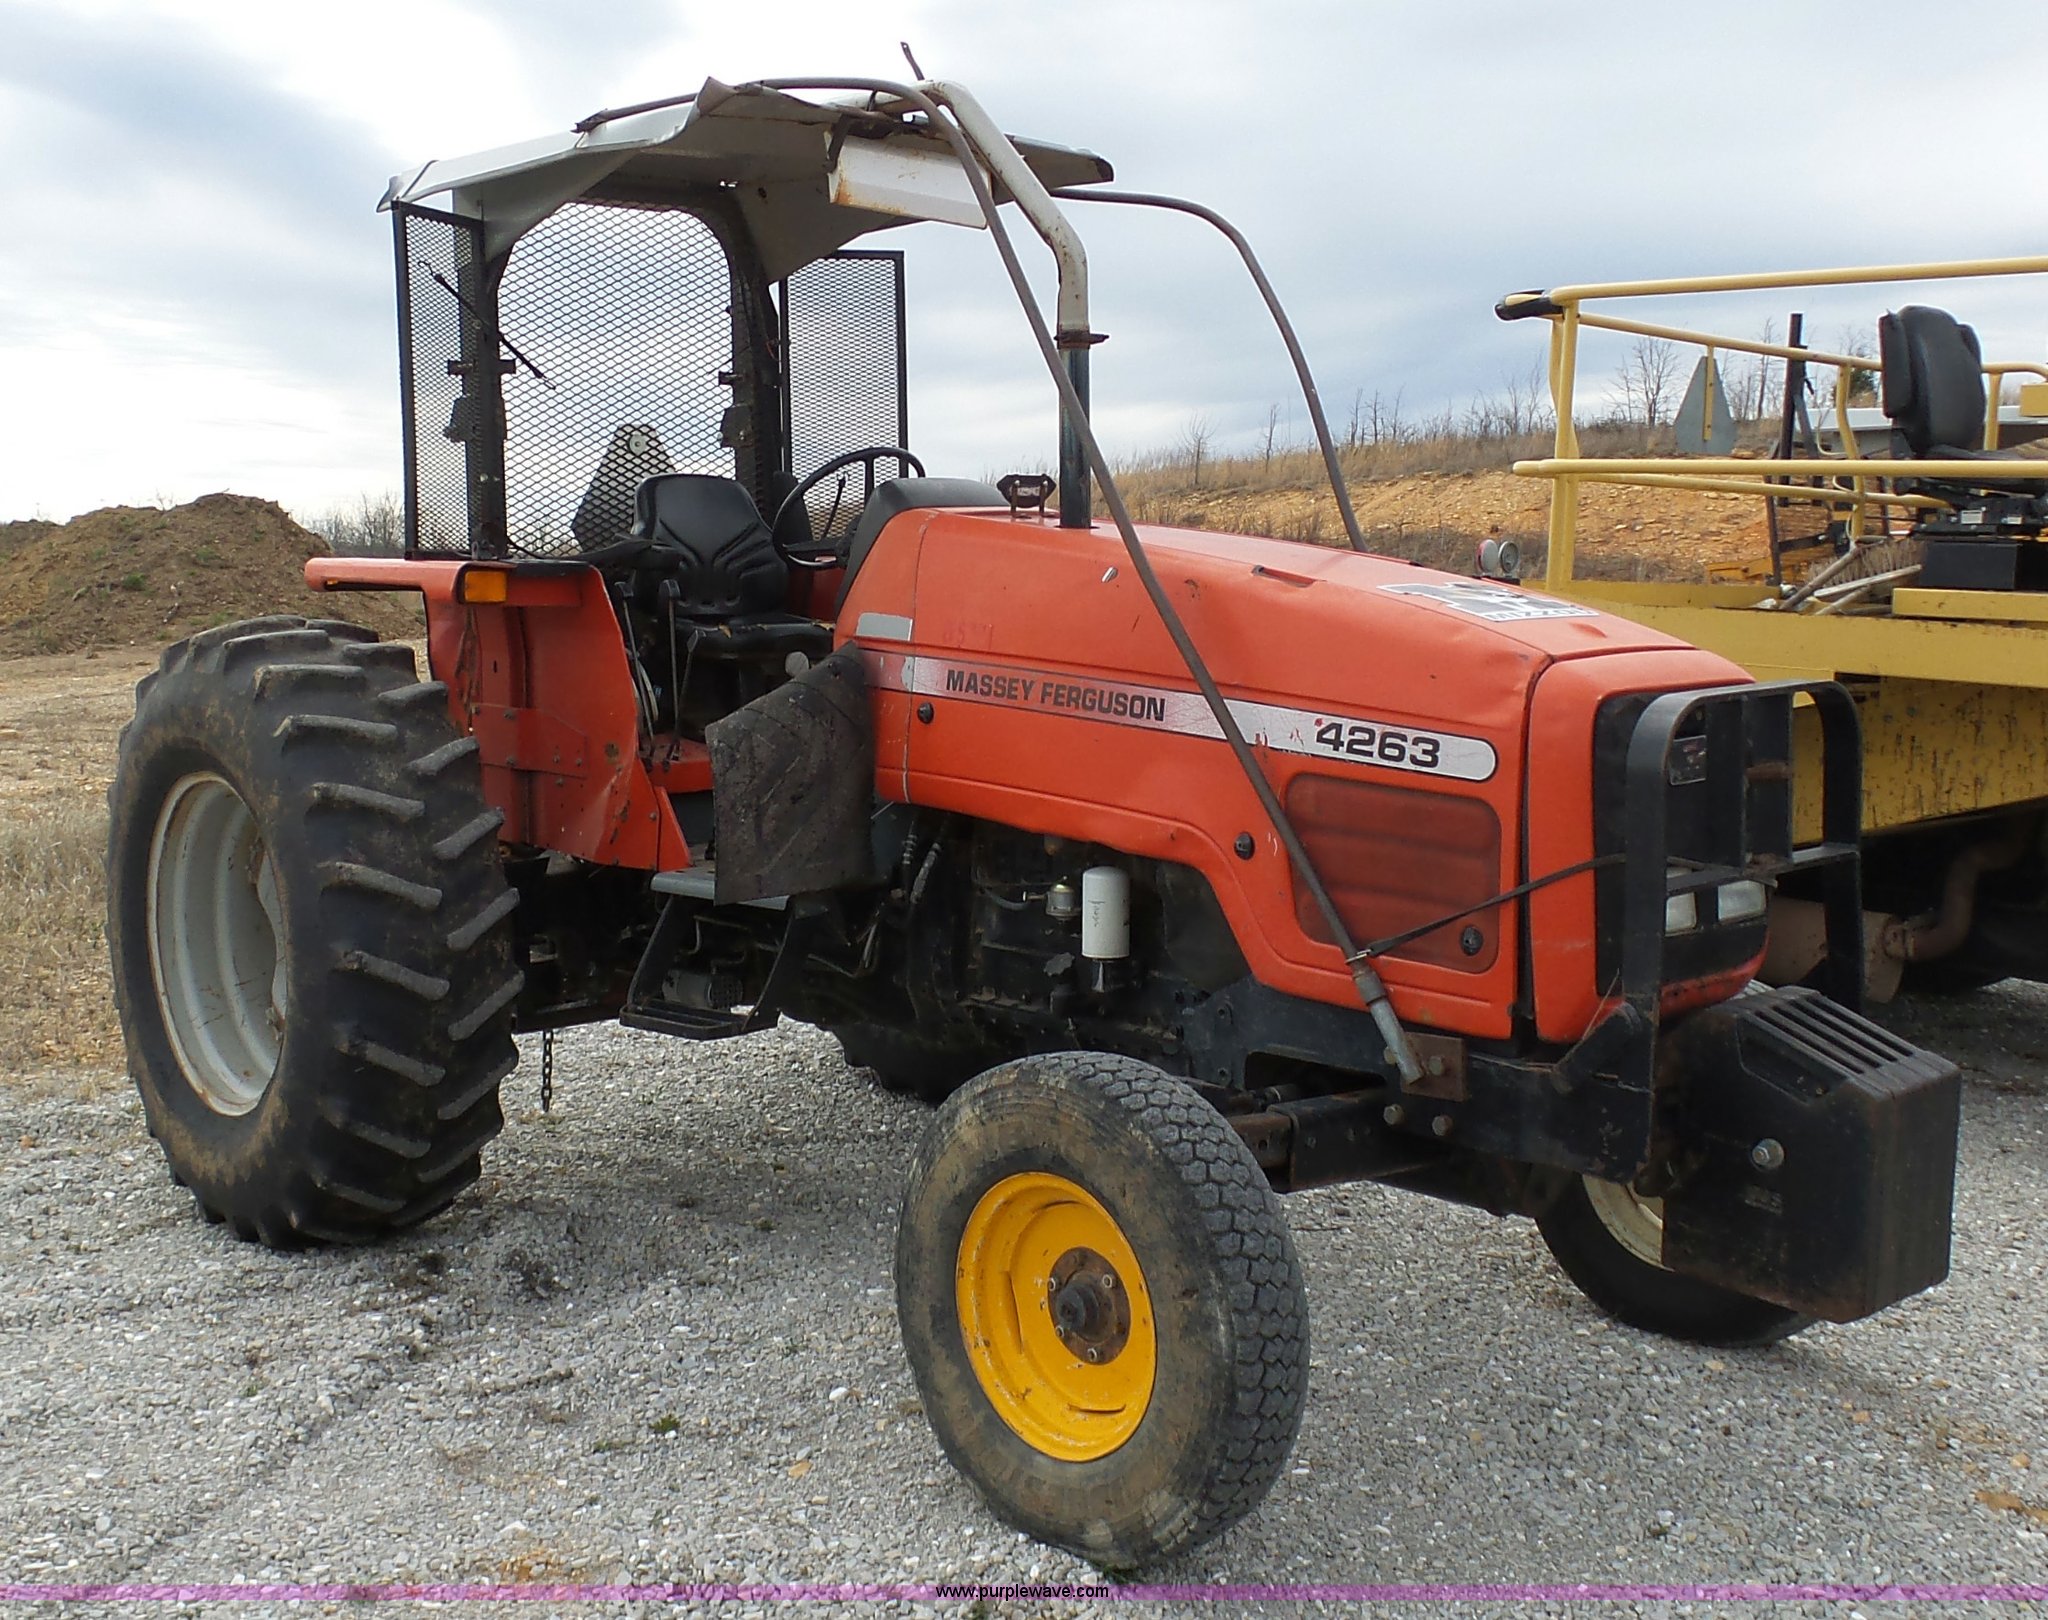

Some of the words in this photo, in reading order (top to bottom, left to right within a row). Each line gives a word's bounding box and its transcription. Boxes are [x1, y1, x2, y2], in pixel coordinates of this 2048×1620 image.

[946, 669, 1035, 701] MASSEY
[1040, 682, 1166, 722] FERGUSON
[1316, 722, 1440, 768] 4263
